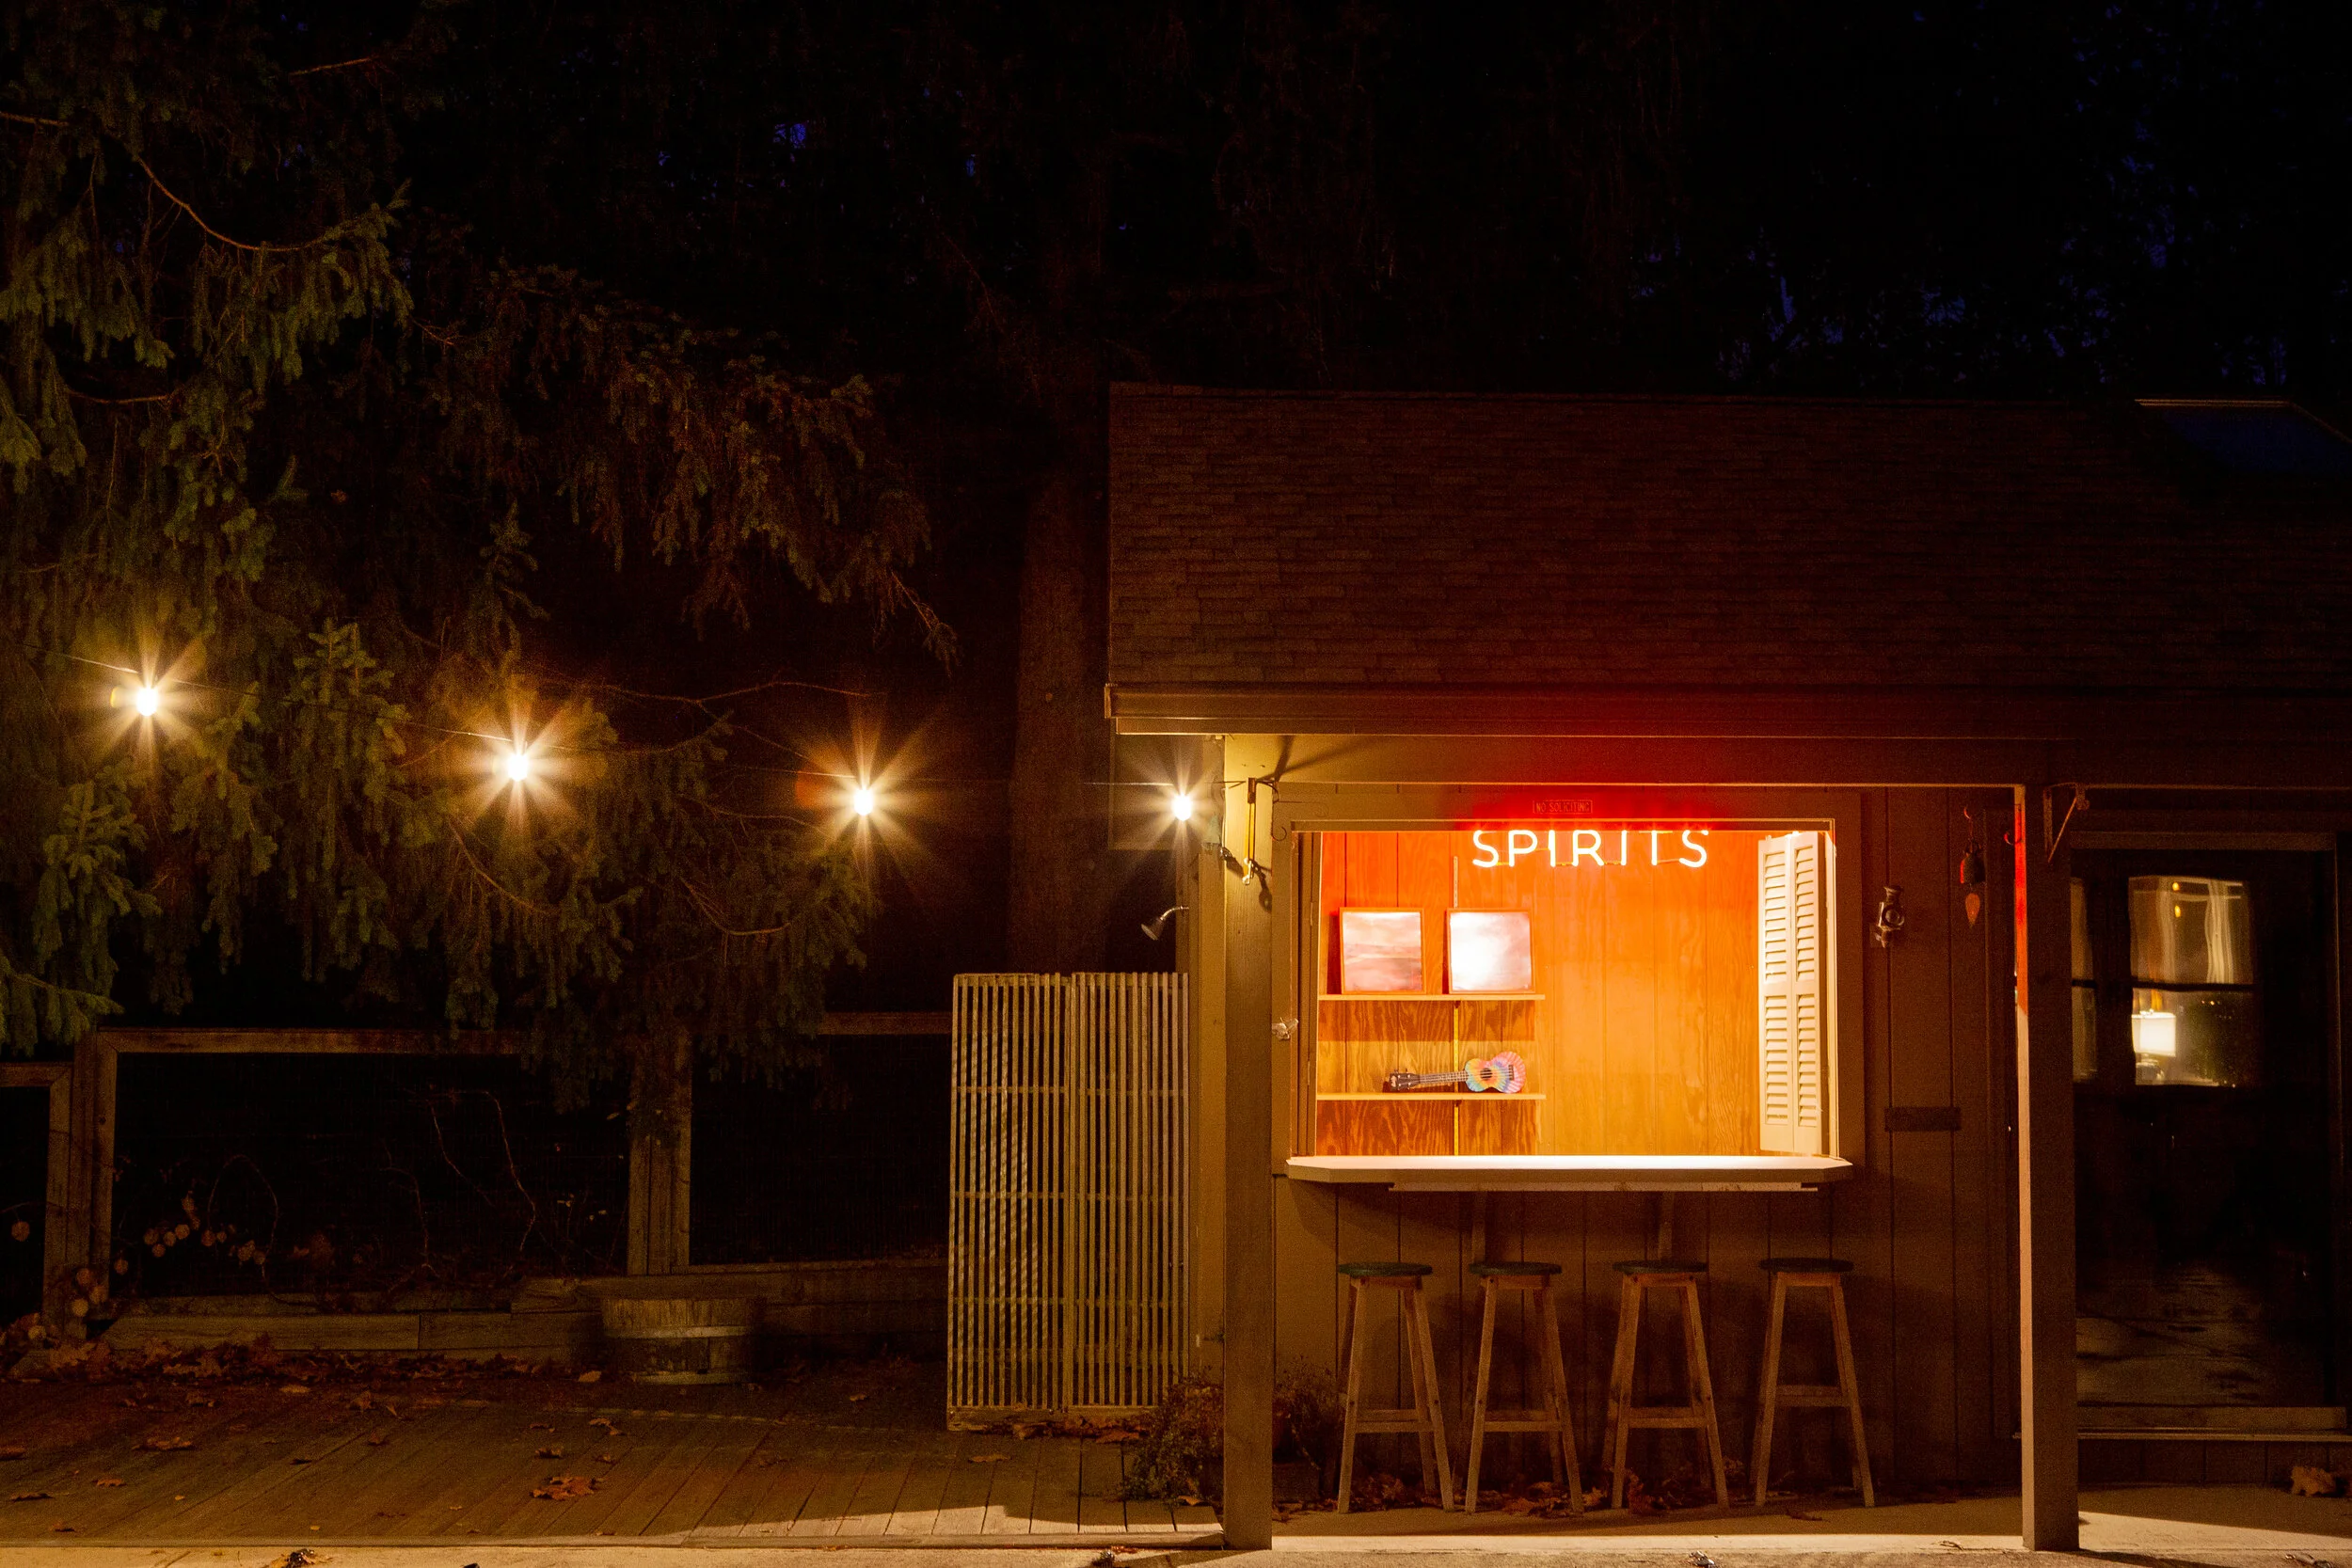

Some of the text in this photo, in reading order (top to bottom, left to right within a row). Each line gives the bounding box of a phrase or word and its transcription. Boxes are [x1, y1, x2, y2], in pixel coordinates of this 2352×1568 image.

[1535, 801, 1590, 813] NO SOLICITING
[1472, 830, 1709, 868] SPIRITS
